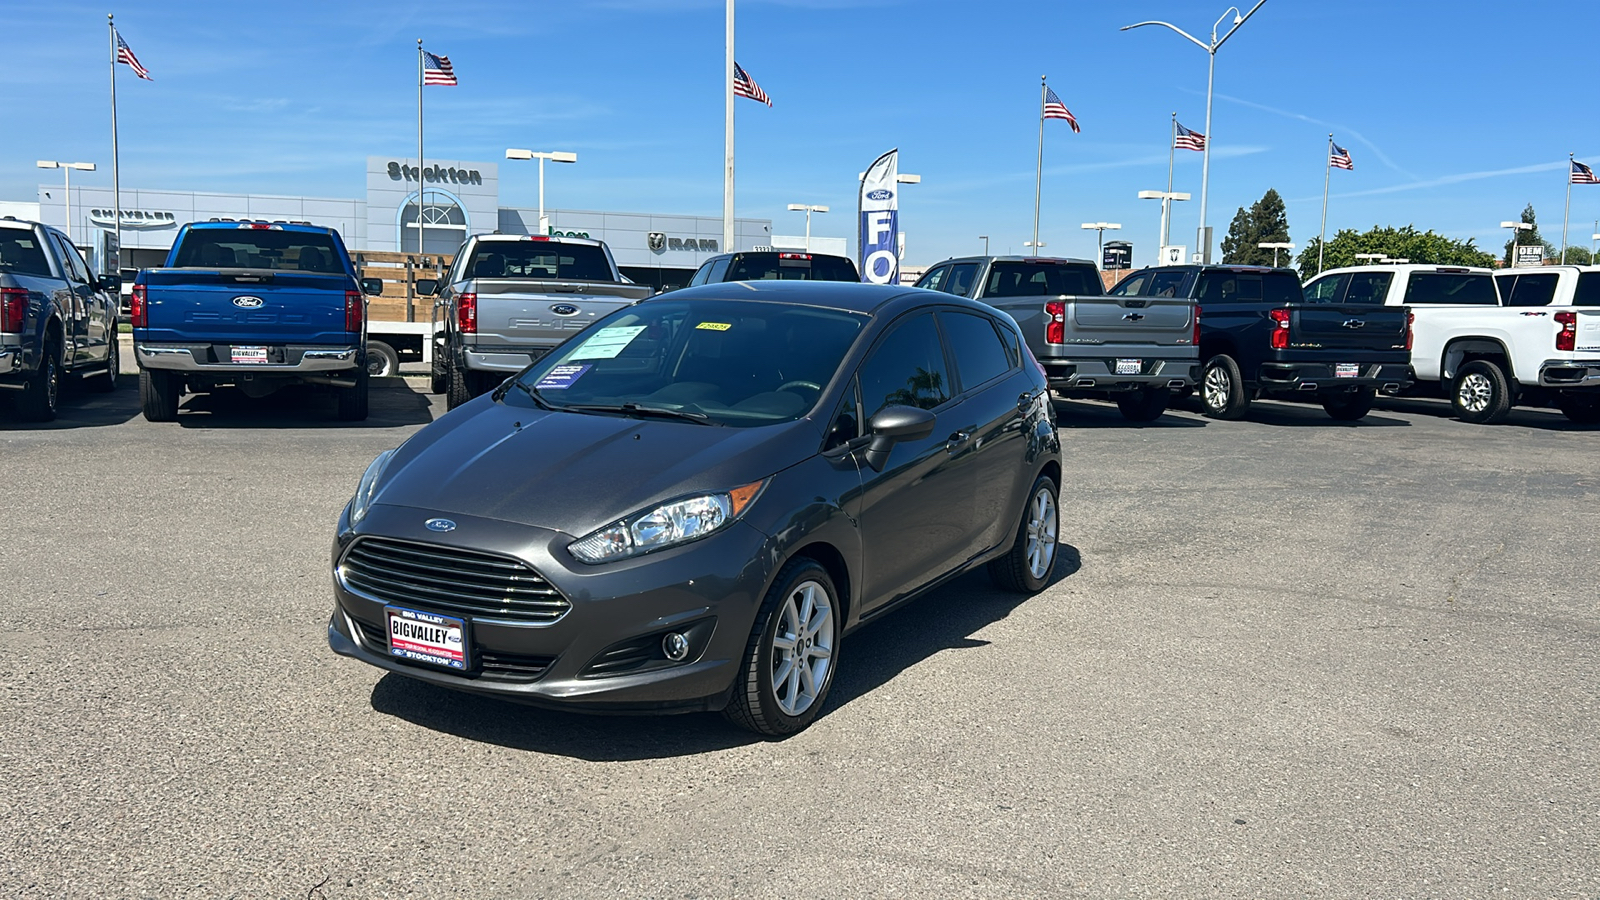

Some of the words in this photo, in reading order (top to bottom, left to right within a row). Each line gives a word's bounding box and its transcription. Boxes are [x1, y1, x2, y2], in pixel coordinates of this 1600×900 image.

[387, 161, 483, 185] Stockton
[870, 188, 891, 200] Ford
[91, 209, 175, 220] CHRYSLER
[668, 237, 718, 252] RAM
[1519, 247, 1542, 255] OEM
[236, 297, 260, 307] Ford
[508, 318, 595, 330] F-15
[416, 613, 444, 624] VALLEY
[393, 620, 448, 644] BIGVALLEY
[406, 651, 449, 665] STOCKTON
